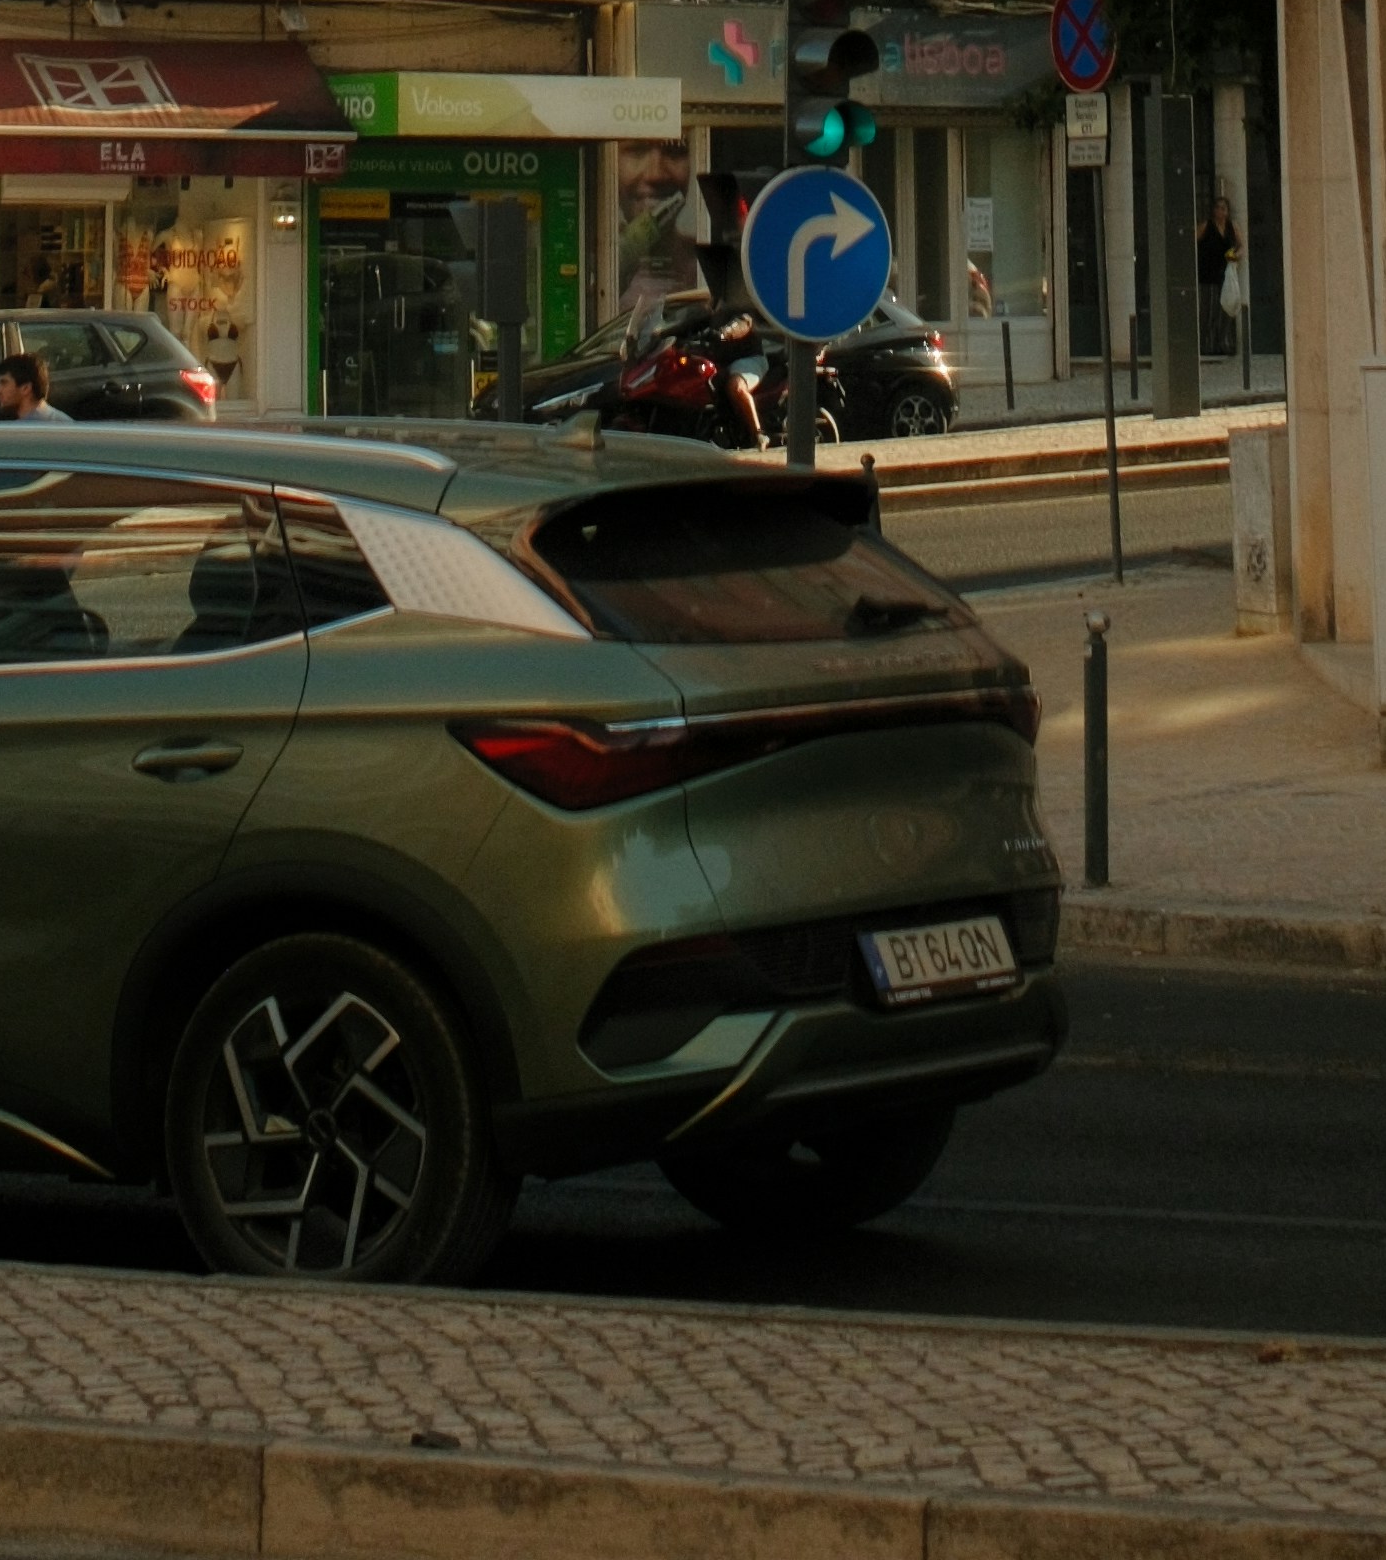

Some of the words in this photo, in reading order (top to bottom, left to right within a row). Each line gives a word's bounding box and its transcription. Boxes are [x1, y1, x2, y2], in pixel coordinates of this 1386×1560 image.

[412, 86, 483, 118] Valores
[613, 104, 669, 122] OURO
[100, 141, 146, 162] ELA
[463, 151, 539, 176] OURO
